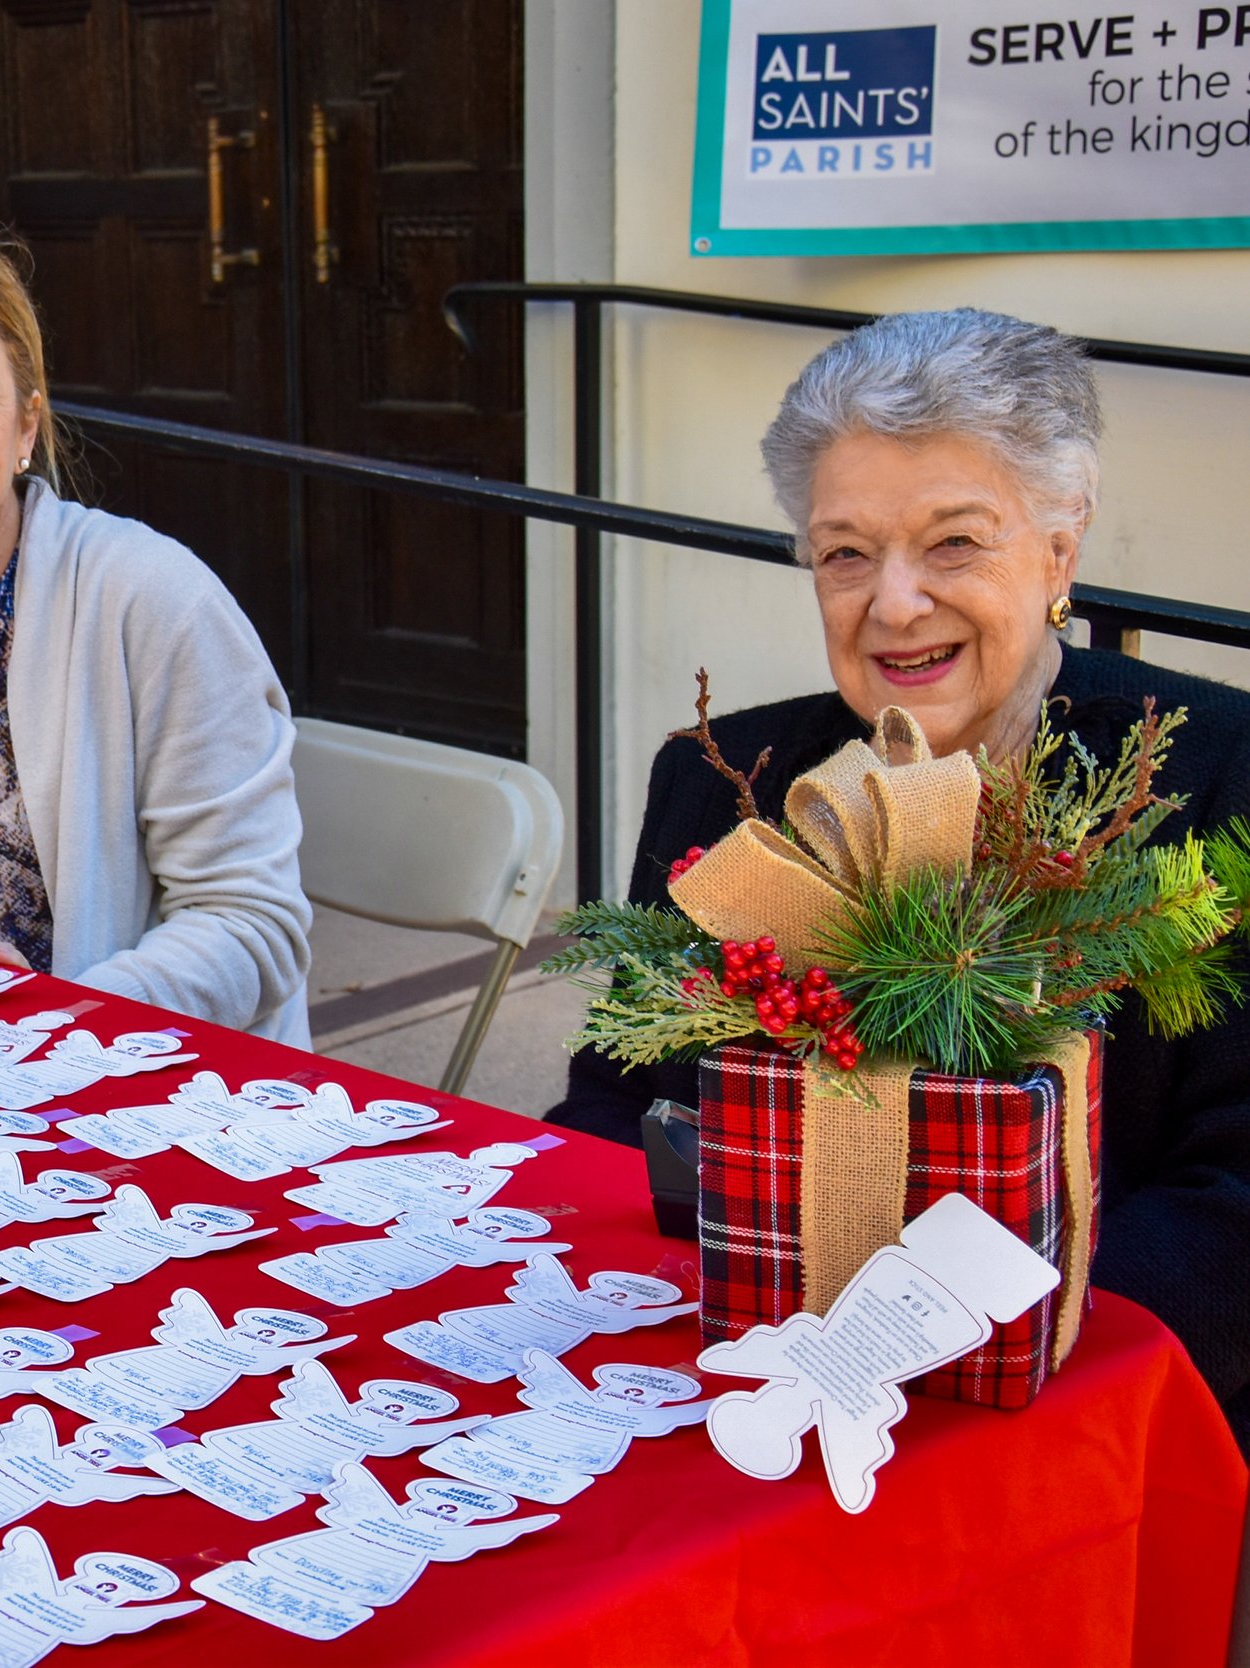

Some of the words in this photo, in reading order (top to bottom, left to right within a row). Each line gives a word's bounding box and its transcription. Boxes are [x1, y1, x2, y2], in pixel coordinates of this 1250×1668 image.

[968, 15, 1135, 67] SERVE
[761, 43, 851, 82] ALL
[1088, 69, 1143, 106] for
[1157, 63, 1230, 102] the
[758, 86, 929, 130] SAINTS'
[994, 121, 1037, 158] of
[1047, 119, 1114, 156] the
[1129, 108, 1250, 158] kingd
[749, 141, 933, 174] PARISH
[604, 1279, 661, 1299] CHRISTMAS!
[623, 1279, 658, 1291] MERRY
[252, 1315, 309, 1335] CHRISTMAS!
[270, 1315, 307, 1328] MERRY
[3, 1336, 54, 1358] CHRISTMAS!
[24, 1336, 55, 1349] MERRY
[610, 1373, 680, 1394] CHRISTMAS!
[631, 1372, 672, 1385] MERRY
[378, 1388, 440, 1411] CHRISTMAS!
[398, 1389, 436, 1403] MERRY
[426, 1487, 497, 1511] CHRISTMAS!
[447, 1487, 492, 1502] MERRY
[95, 1563, 157, 1592] CHRISTMAS!
[117, 1564, 157, 1581] MERRY
